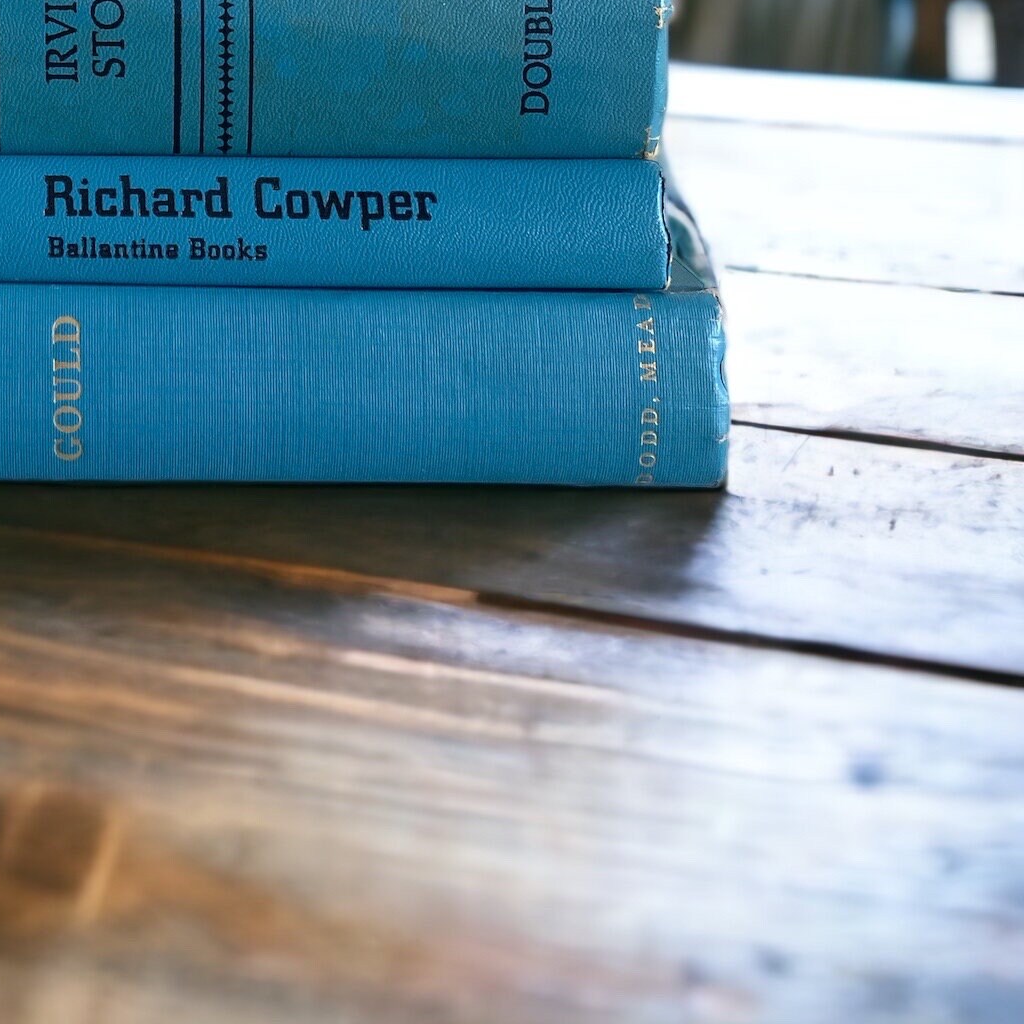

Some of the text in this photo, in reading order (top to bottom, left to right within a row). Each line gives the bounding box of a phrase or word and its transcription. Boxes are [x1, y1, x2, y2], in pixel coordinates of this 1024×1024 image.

[43, 175, 437, 231] Richard Cowper
[48, 236, 268, 262] Ballantine Books
[52, 315, 84, 461] GOULD
